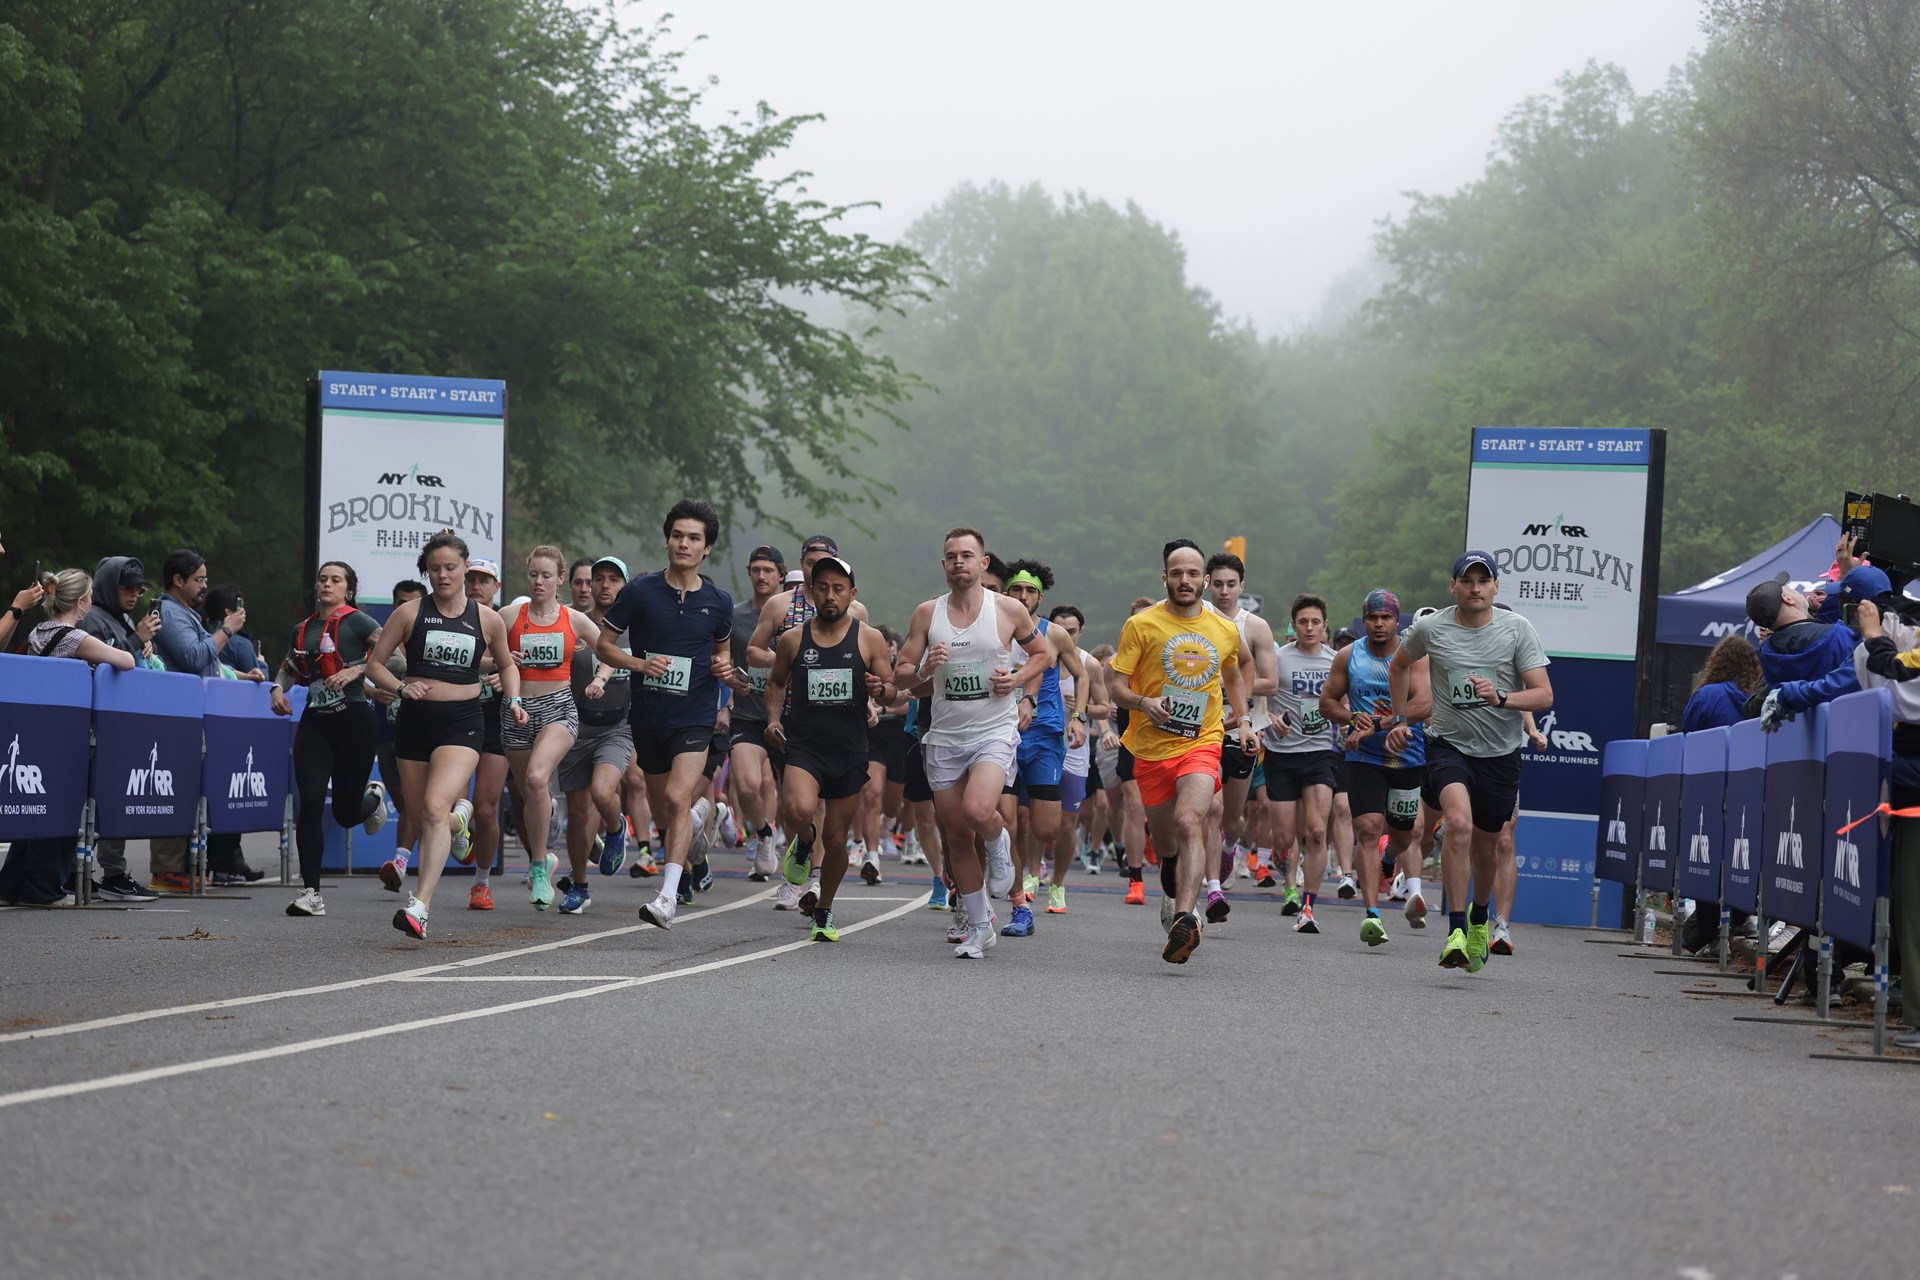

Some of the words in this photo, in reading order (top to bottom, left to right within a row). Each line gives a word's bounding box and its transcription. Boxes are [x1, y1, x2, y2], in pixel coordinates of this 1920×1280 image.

[330, 383, 377, 396] START
[390, 386, 436, 400] START
[450, 390, 496, 403] START
[1481, 440, 1526, 450] START
[1539, 440, 1584, 451] START
[1597, 441, 1643, 452] START
[328, 493, 494, 541] BROOKLYN
[1493, 544, 1634, 592] ROOKLYN
[1564, 583, 1584, 601] 5K
[435, 646, 468, 664] 3646
[818, 682, 847, 697] 2564
[1358, 688, 1370, 697] La
[1183, 729, 1196, 738] 3224
[1560, 756, 1599, 765] RUNNERS
[126, 769, 174, 796] NYRR
[228, 772, 267, 798] NYRR
[4, 805, 20, 814] ROAD
[21, 805, 46, 814] RUNNERS
[126, 806, 135, 814] NEW
[136, 806, 146, 814] YORK
[146, 806, 156, 814] ROAD
[157, 806, 174, 814] RUNNERS
